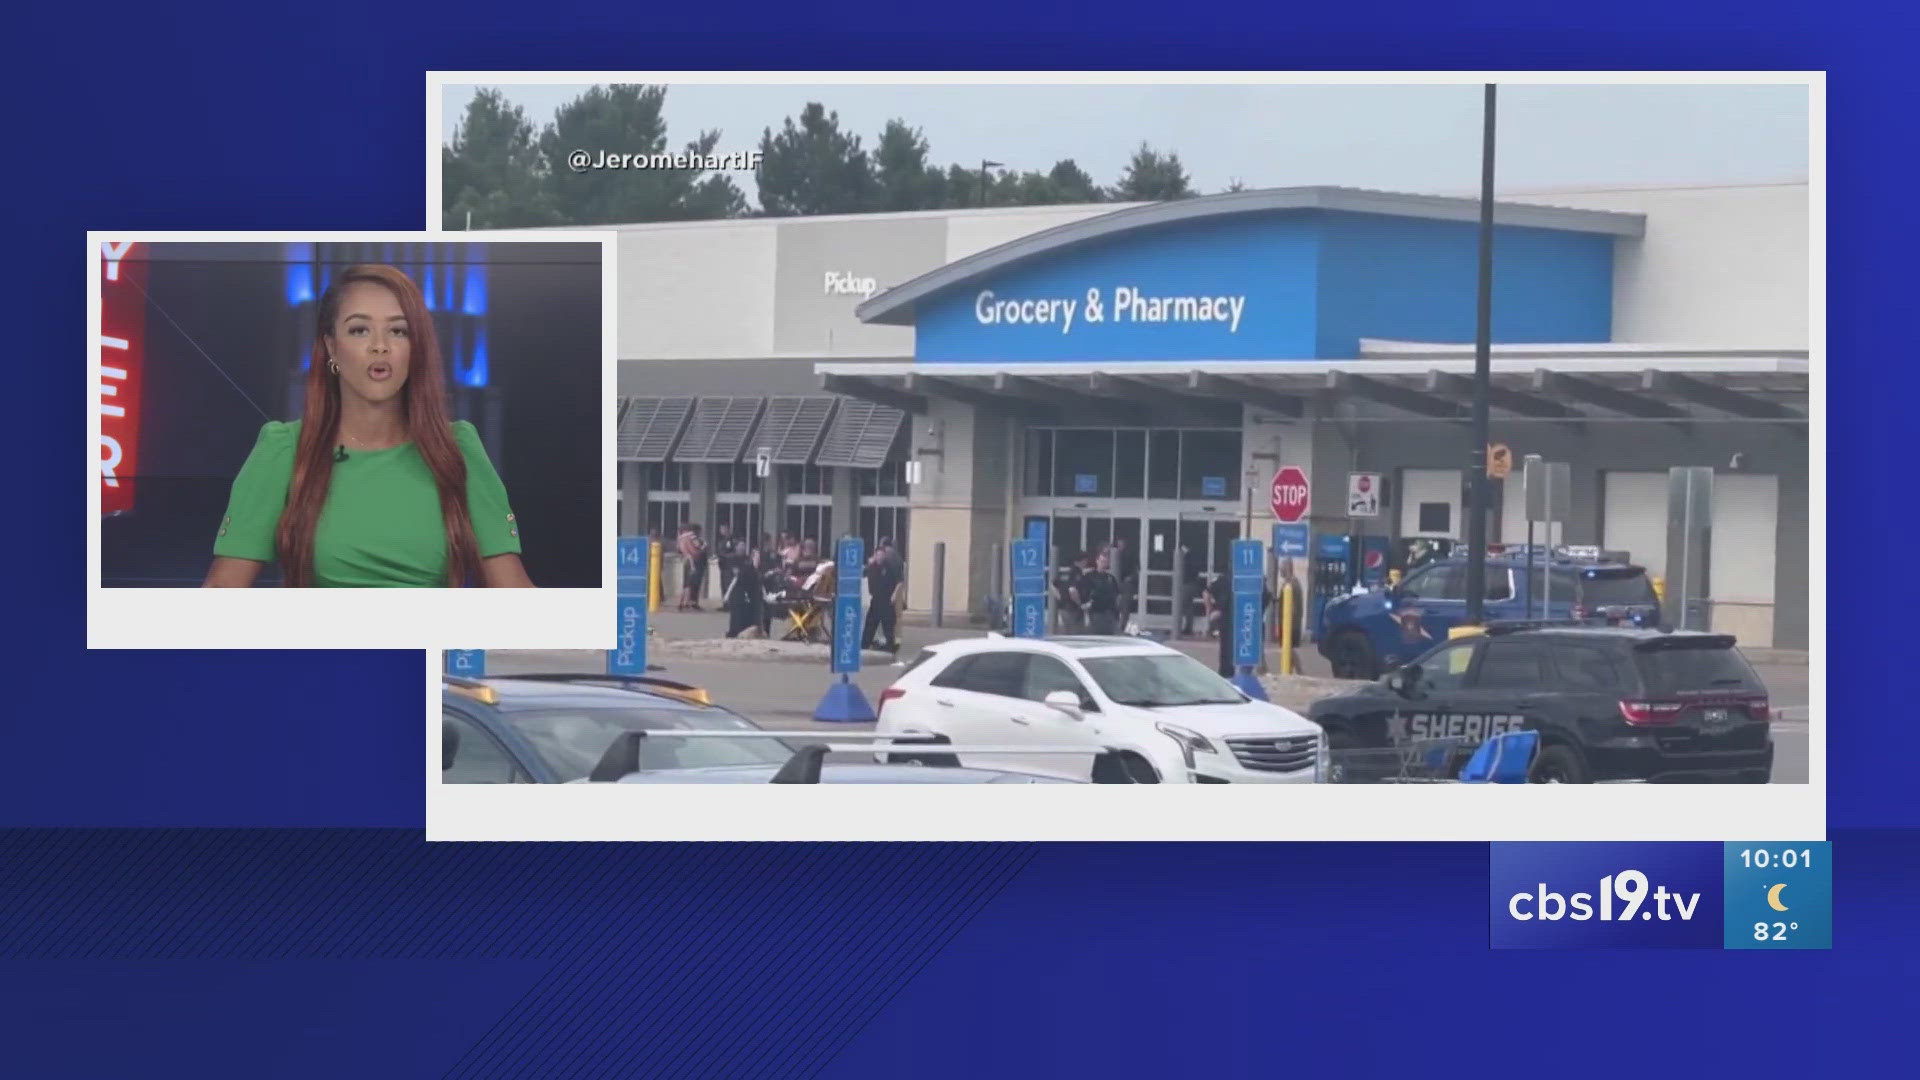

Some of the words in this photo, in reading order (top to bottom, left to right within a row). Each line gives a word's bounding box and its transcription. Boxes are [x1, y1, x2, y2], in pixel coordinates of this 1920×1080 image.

[824, 271, 877, 301] Pickup
[975, 290, 1077, 334] Grocery
[1084, 287, 1105, 323] &
[1114, 286, 1246, 333] Pharmacy
[1274, 485, 1307, 506] STOP
[620, 546, 639, 565] 14
[844, 548, 858, 567] 13
[1021, 547, 1038, 567] 12
[1243, 549, 1255, 566] 11
[617, 606, 640, 667] Pickup
[840, 606, 858, 664] Pickup
[1240, 602, 1256, 657] Pickup
[1410, 713, 1525, 745] SHERIFF
